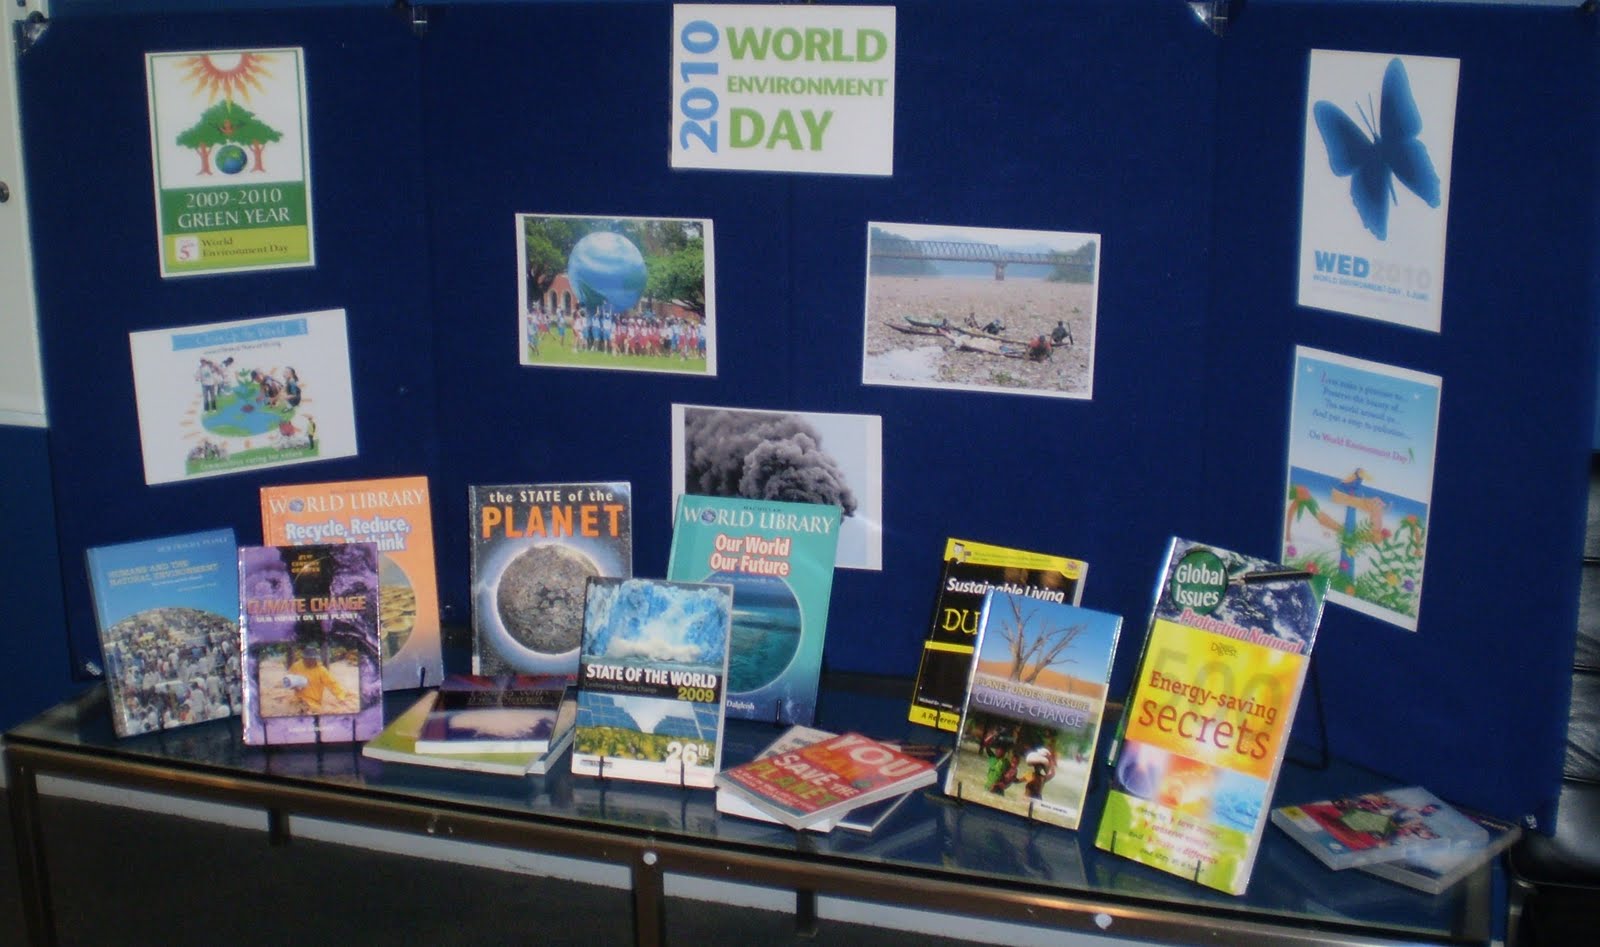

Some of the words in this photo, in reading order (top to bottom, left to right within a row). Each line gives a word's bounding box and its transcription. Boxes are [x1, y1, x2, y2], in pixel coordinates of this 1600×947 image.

[726, 27, 888, 62] WORLD
[679, 20, 720, 153] 2010
[727, 75, 888, 96] ENVIRONMENT
[729, 107, 834, 152] DAY
[185, 188, 282, 208] 2009-2010
[178, 211, 239, 228] GREEN
[244, 207, 290, 223] YEAR
[201, 237, 233, 247] World
[202, 245, 267, 257] Environment
[270, 244, 288, 255] Day
[1314, 250, 1370, 278] WED
[1321, 433, 1344, 447] World
[351, 489, 425, 510] LIBRARY
[489, 491, 513, 503] the
[520, 490, 561, 503] STATE
[568, 490, 583, 502] of
[589, 490, 613, 502] the
[285, 520, 348, 541] Recycle,
[350, 516, 410, 536] Reduce,
[482, 504, 625, 539] PLANET
[760, 511, 834, 534] LIBRARY
[715, 534, 743, 553] Our
[744, 535, 790, 556] World
[710, 553, 738, 571] Our
[741, 555, 789, 576] Future
[1176, 563, 1224, 585] Global
[248, 598, 306, 614] CLIMATE
[310, 595, 367, 613] CHANGE
[1176, 584, 1219, 607] Issues
[1247, 626, 1305, 654] Natural
[586, 664, 623, 681] STATE
[625, 667, 642, 682] OF
[644, 668, 668, 685] THE
[671, 671, 717, 688] WORLD
[677, 687, 715, 702] 2009
[1011, 686, 1041, 699] UNDER
[1149, 670, 1278, 726] Energy-saving
[976, 691, 1024, 713] CLIMATE
[1029, 705, 1084, 728] CHANGE
[1138, 699, 1270, 760] secrets
[827, 734, 923, 777] YOU
[774, 755, 839, 786] SAVE
[830, 783, 860, 797] THE
